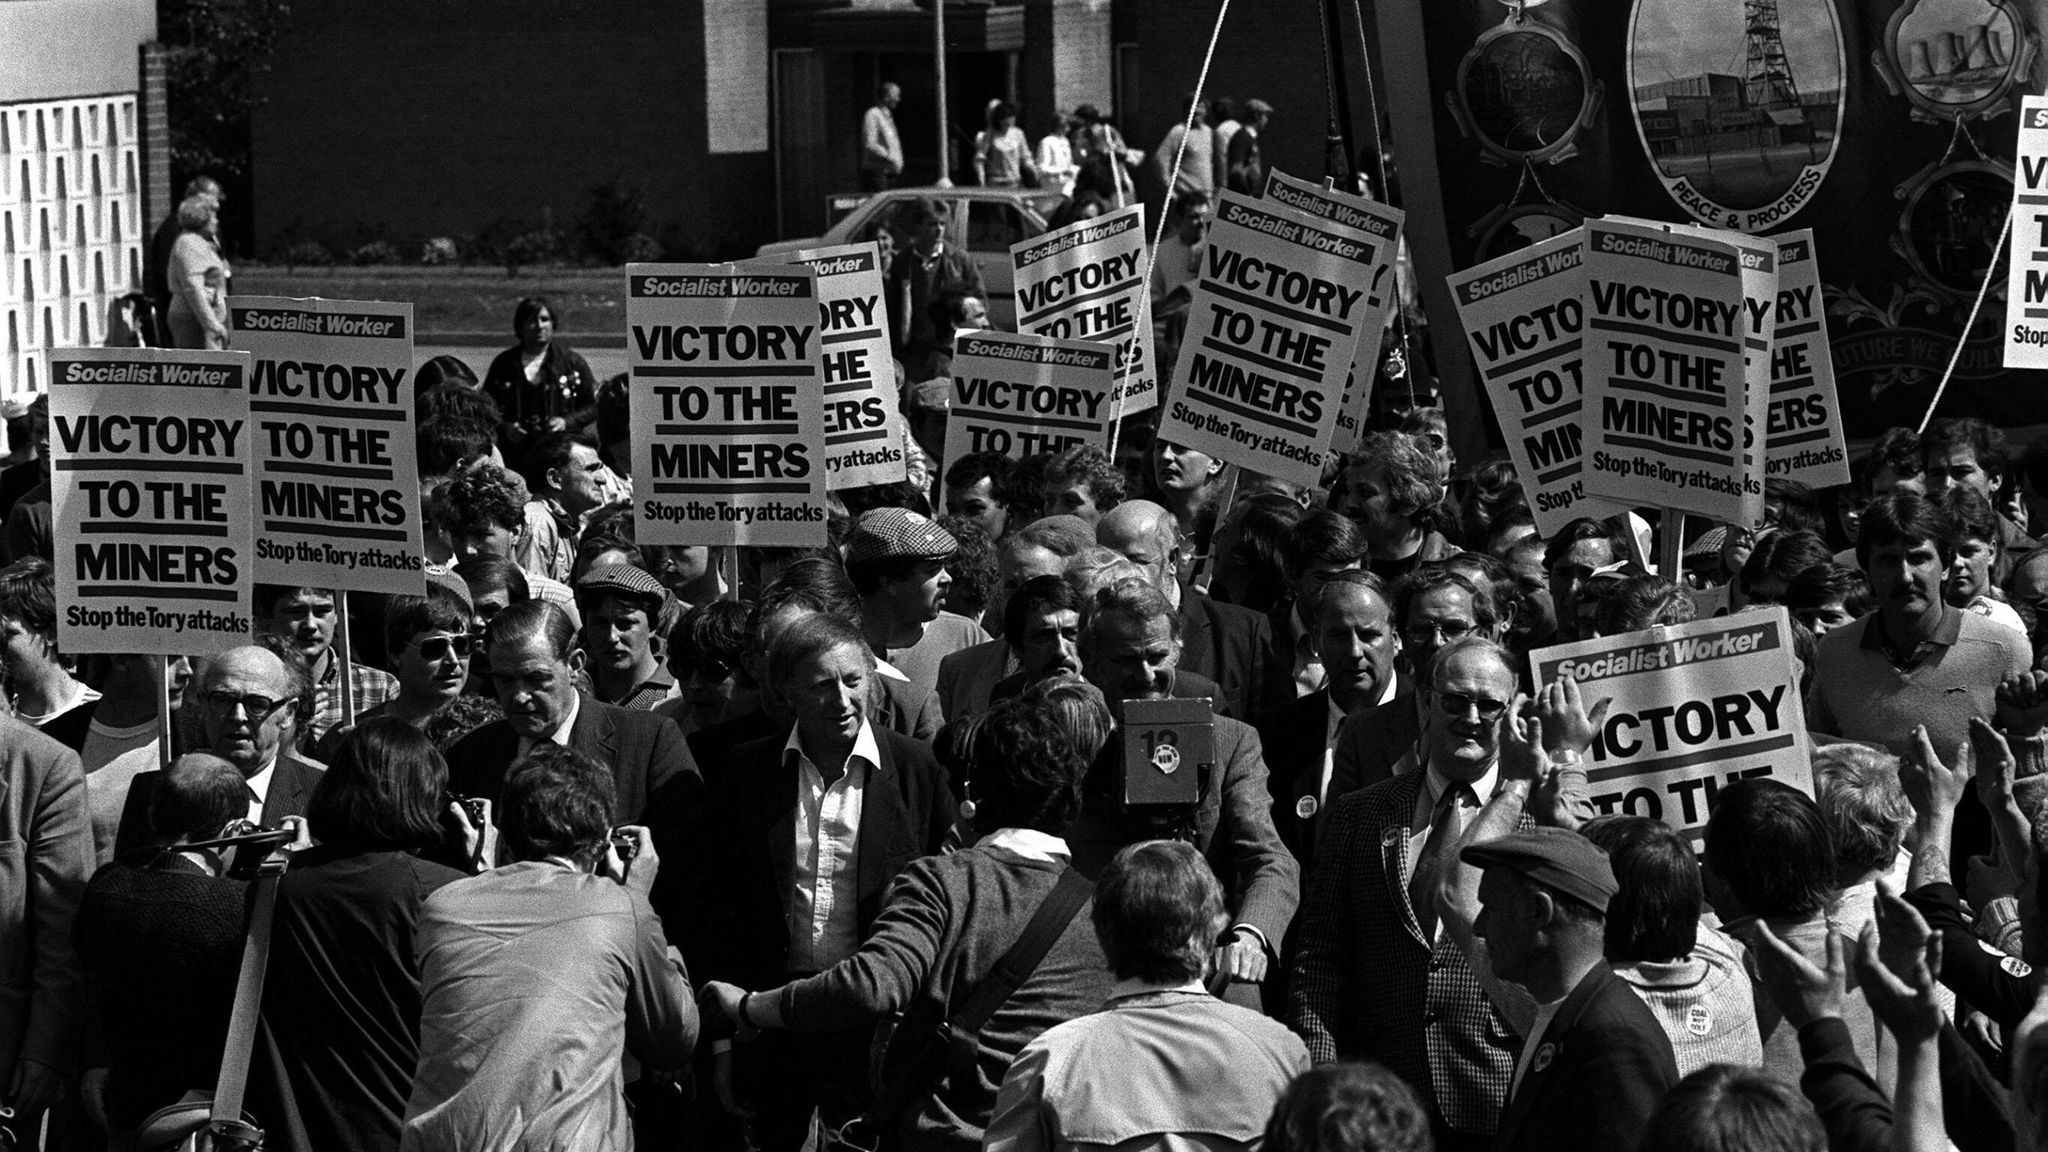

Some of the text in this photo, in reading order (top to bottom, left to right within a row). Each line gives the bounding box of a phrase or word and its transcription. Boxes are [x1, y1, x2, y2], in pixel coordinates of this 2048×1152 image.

[1272, 182, 1389, 235] Socialist Worker
[1672, 169, 1821, 230] PEACE & PROGRESS
[1022, 219, 1131, 265] Socialist Worker
[1227, 204, 1364, 260] Socialist Worker
[1602, 233, 1730, 272] Socialist Worker
[1468, 245, 1584, 300] Socialist Wor
[1740, 249, 1765, 269] ker
[1779, 247, 1801, 263] ker
[643, 277, 800, 296] Socialist Worker
[1018, 248, 1141, 313] VICTORY
[1208, 243, 1363, 320] VICTORY
[244, 310, 393, 336] Socialist Worker
[1035, 297, 1133, 339] TO THE
[1471, 295, 1583, 362] VICTO
[1590, 280, 1740, 337] VICTORY
[632, 325, 814, 361] VICTORY
[967, 340, 1040, 361] Socialist
[1041, 347, 1100, 367] Worker
[1210, 303, 1332, 371] TO THE
[1836, 336, 1905, 367] UTURE
[66, 361, 231, 386] Socialist Worker
[250, 360, 406, 404] VICTORY
[822, 349, 871, 383] HE
[1607, 340, 1656, 378] TO
[1659, 349, 1726, 394] THE
[1771, 343, 1812, 380] HE
[654, 386, 798, 421] TO THE
[954, 377, 1106, 418] VICTORY
[1188, 353, 1325, 424] MINERS
[1508, 369, 1563, 413] TO
[824, 398, 886, 433] ERS
[1171, 401, 1322, 468] Stop the Tory attacks
[1603, 397, 1734, 451] MINERS
[1767, 394, 1827, 435] ERS
[54, 415, 244, 457] VICTORY
[261, 421, 393, 466] TO THE
[966, 425, 1084, 457] TO THE
[1523, 422, 1583, 471] MIN
[651, 443, 810, 479] MINERS
[825, 447, 901, 473] ry attacks
[1593, 451, 1631, 479] Stop
[1632, 458, 1657, 480] the
[1657, 460, 1688, 488] Tory
[1689, 469, 1743, 498] attacks
[1766, 446, 1843, 475] ory attacks
[79, 480, 228, 522] TO THE
[261, 480, 406, 526] MINERS
[644, 501, 823, 525] Stop the Tory attacks
[1536, 486, 1573, 514] Stop
[75, 543, 238, 586] MINERS
[257, 538, 422, 571] Stop the Tory attacks
[67, 605, 249, 633] Stop the Tory attacks
[1557, 631, 1764, 683] Socialist Worker
[1591, 685, 1787, 762] ICTORY
